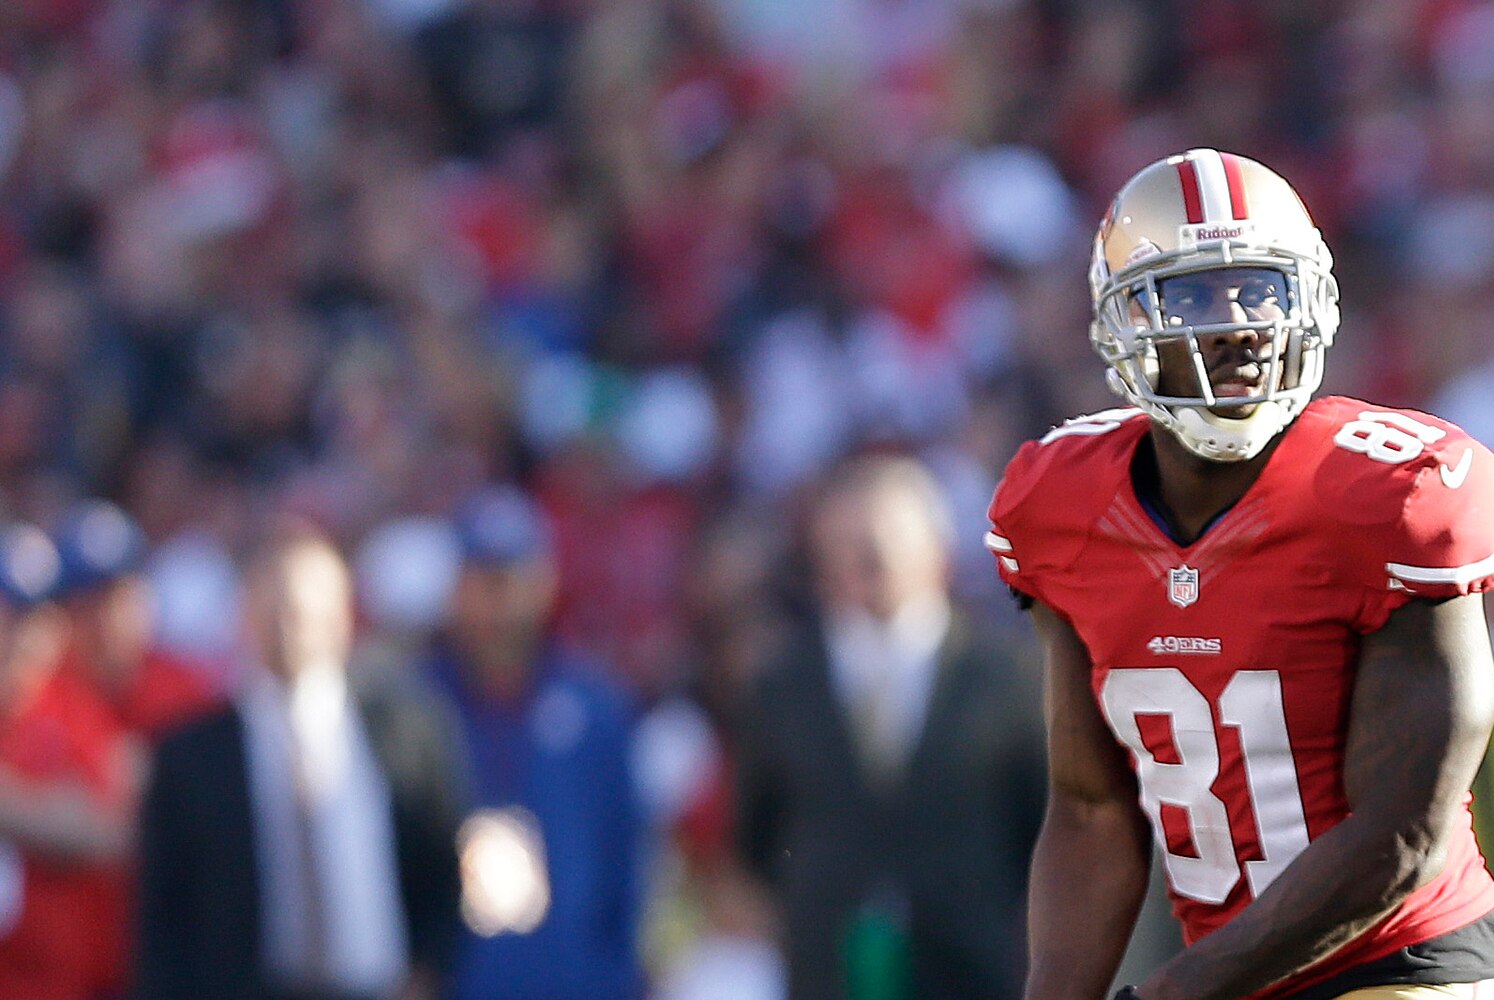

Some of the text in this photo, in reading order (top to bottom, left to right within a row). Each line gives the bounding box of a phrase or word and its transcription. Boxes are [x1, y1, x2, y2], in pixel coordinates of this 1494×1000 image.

[1333, 400, 1447, 464] 81
[1146, 636, 1222, 654] 49ERS
[1101, 667, 1311, 904] 81
